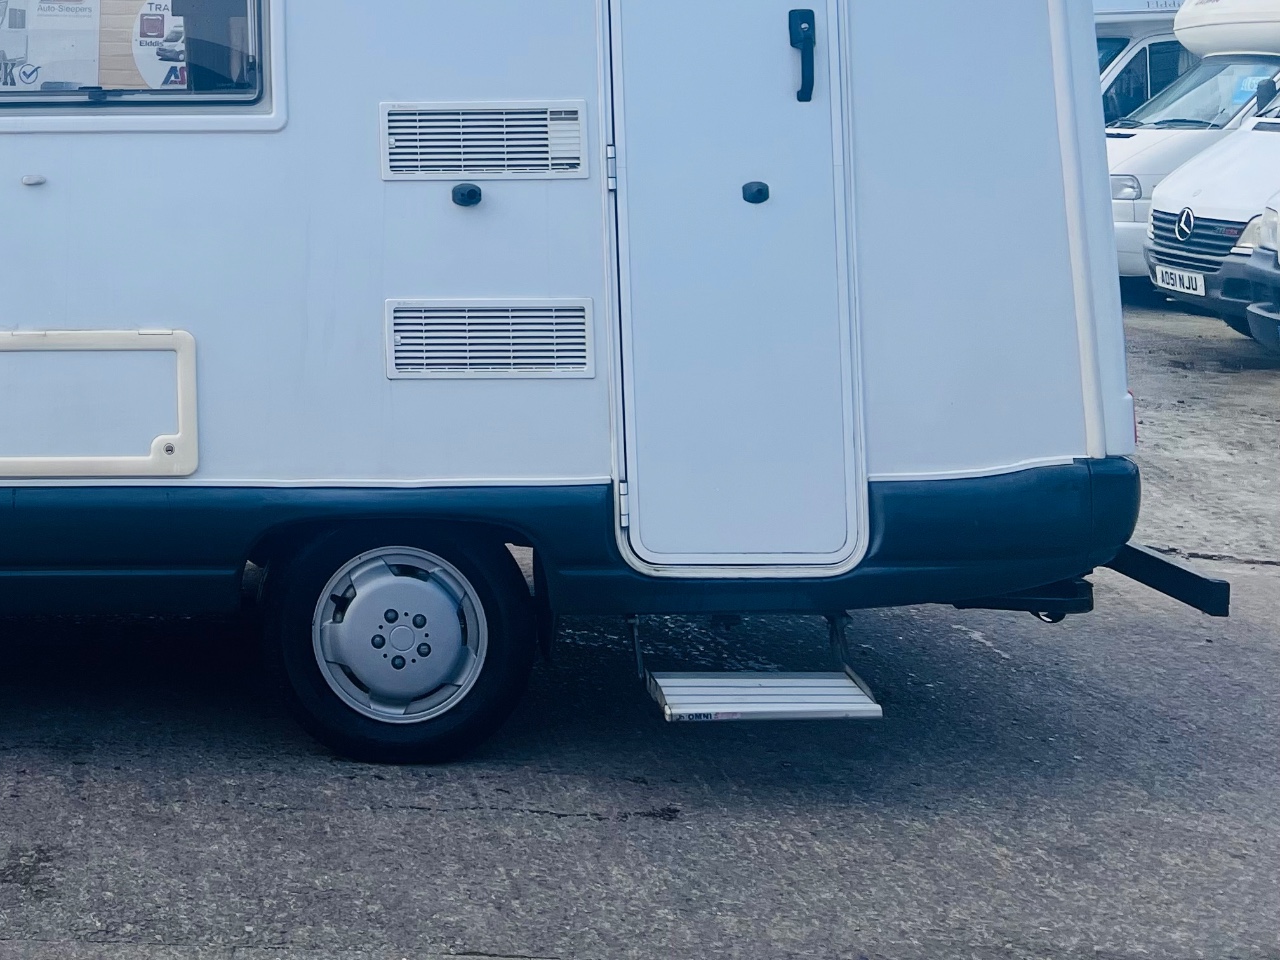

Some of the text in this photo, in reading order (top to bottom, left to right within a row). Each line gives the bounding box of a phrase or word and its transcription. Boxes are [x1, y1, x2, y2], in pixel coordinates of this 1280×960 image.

[37, 4, 93, 14] Auto-Sleepers
[1178, 273, 1198, 292] NJU
[687, 712, 713, 721] OMNI
